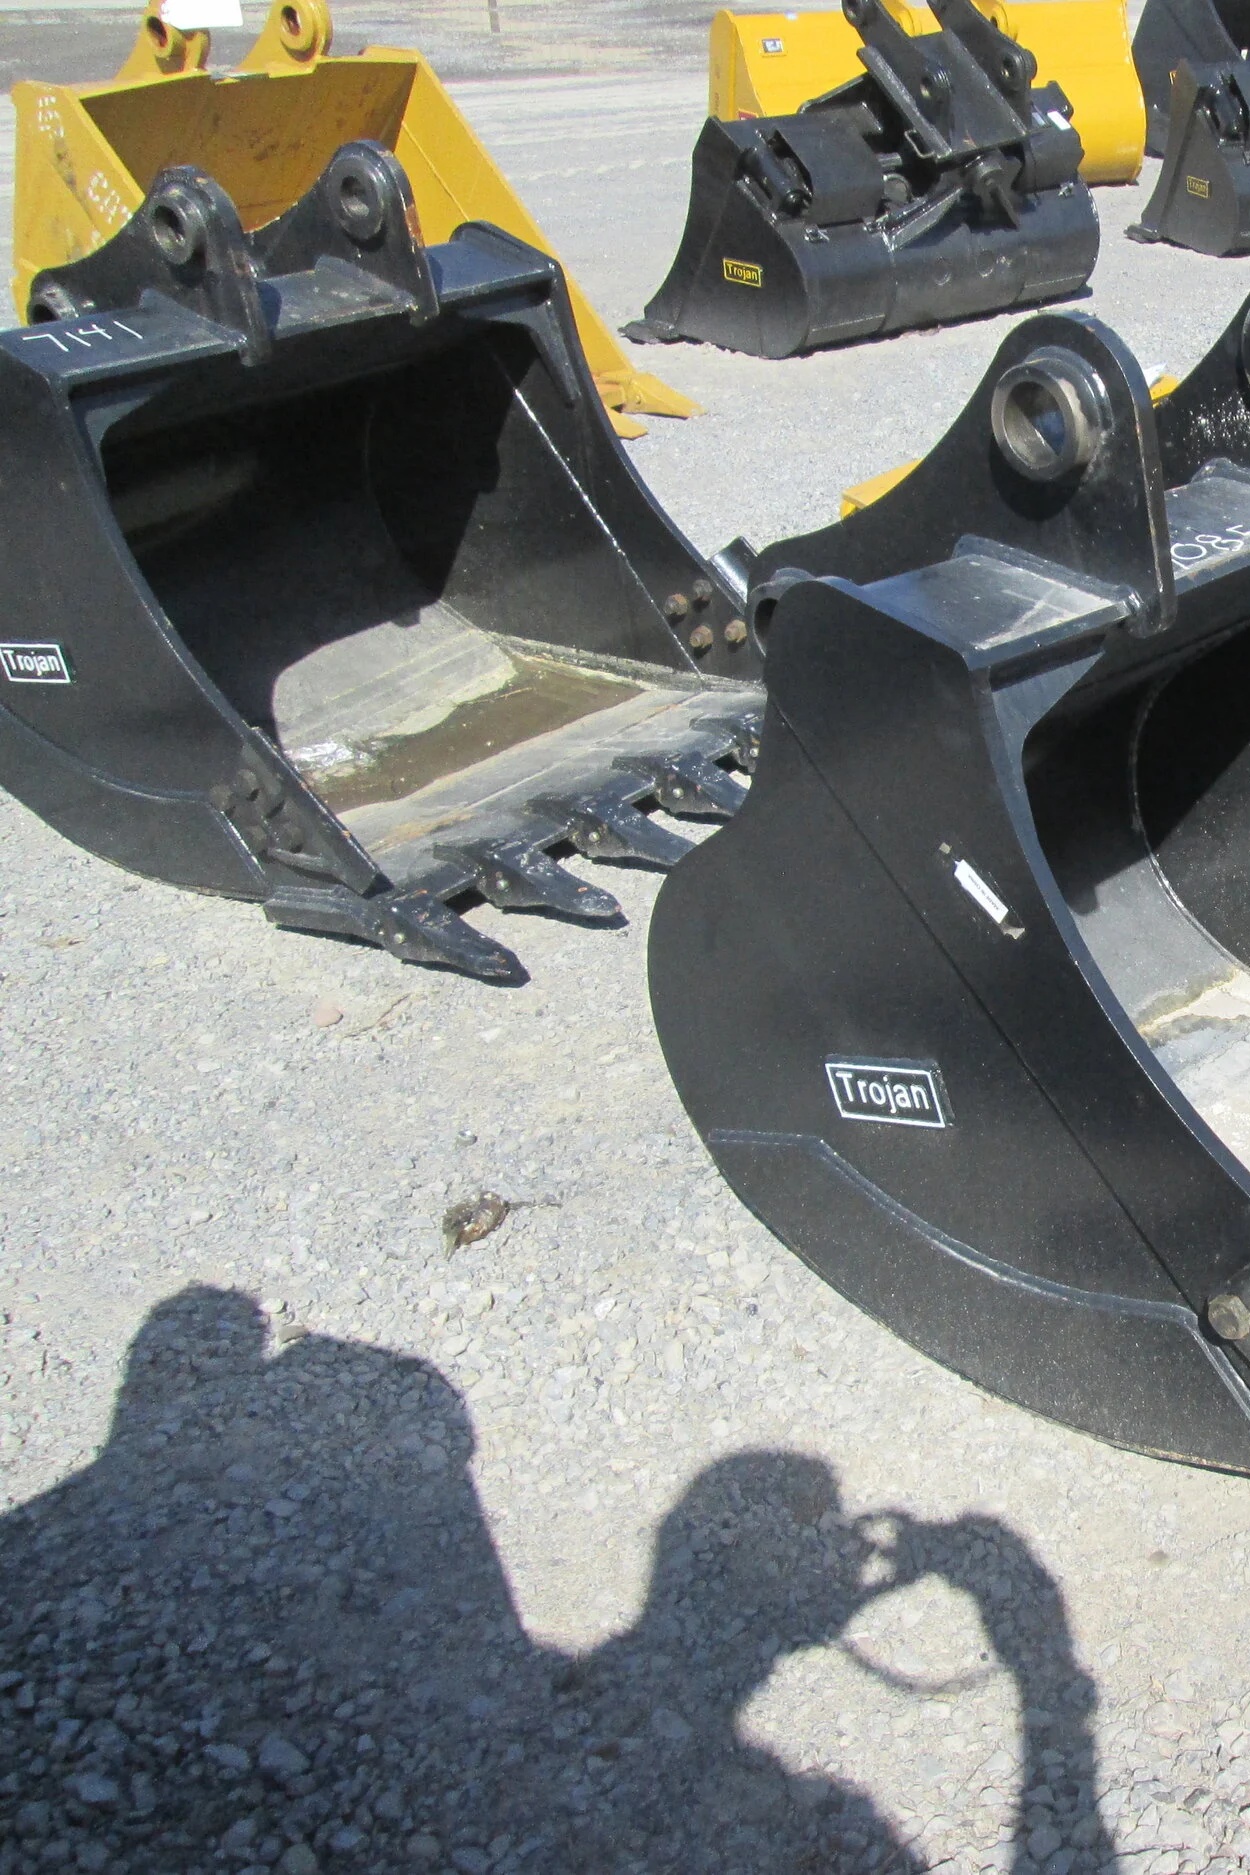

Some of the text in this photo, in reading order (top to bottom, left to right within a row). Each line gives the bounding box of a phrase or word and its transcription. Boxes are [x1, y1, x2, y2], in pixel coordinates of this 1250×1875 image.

[726, 262, 758, 281] Trojan
[20, 319, 144, 352] 7141
[3, 649, 61, 677] Trojan
[835, 1071, 930, 1113] Trojan
